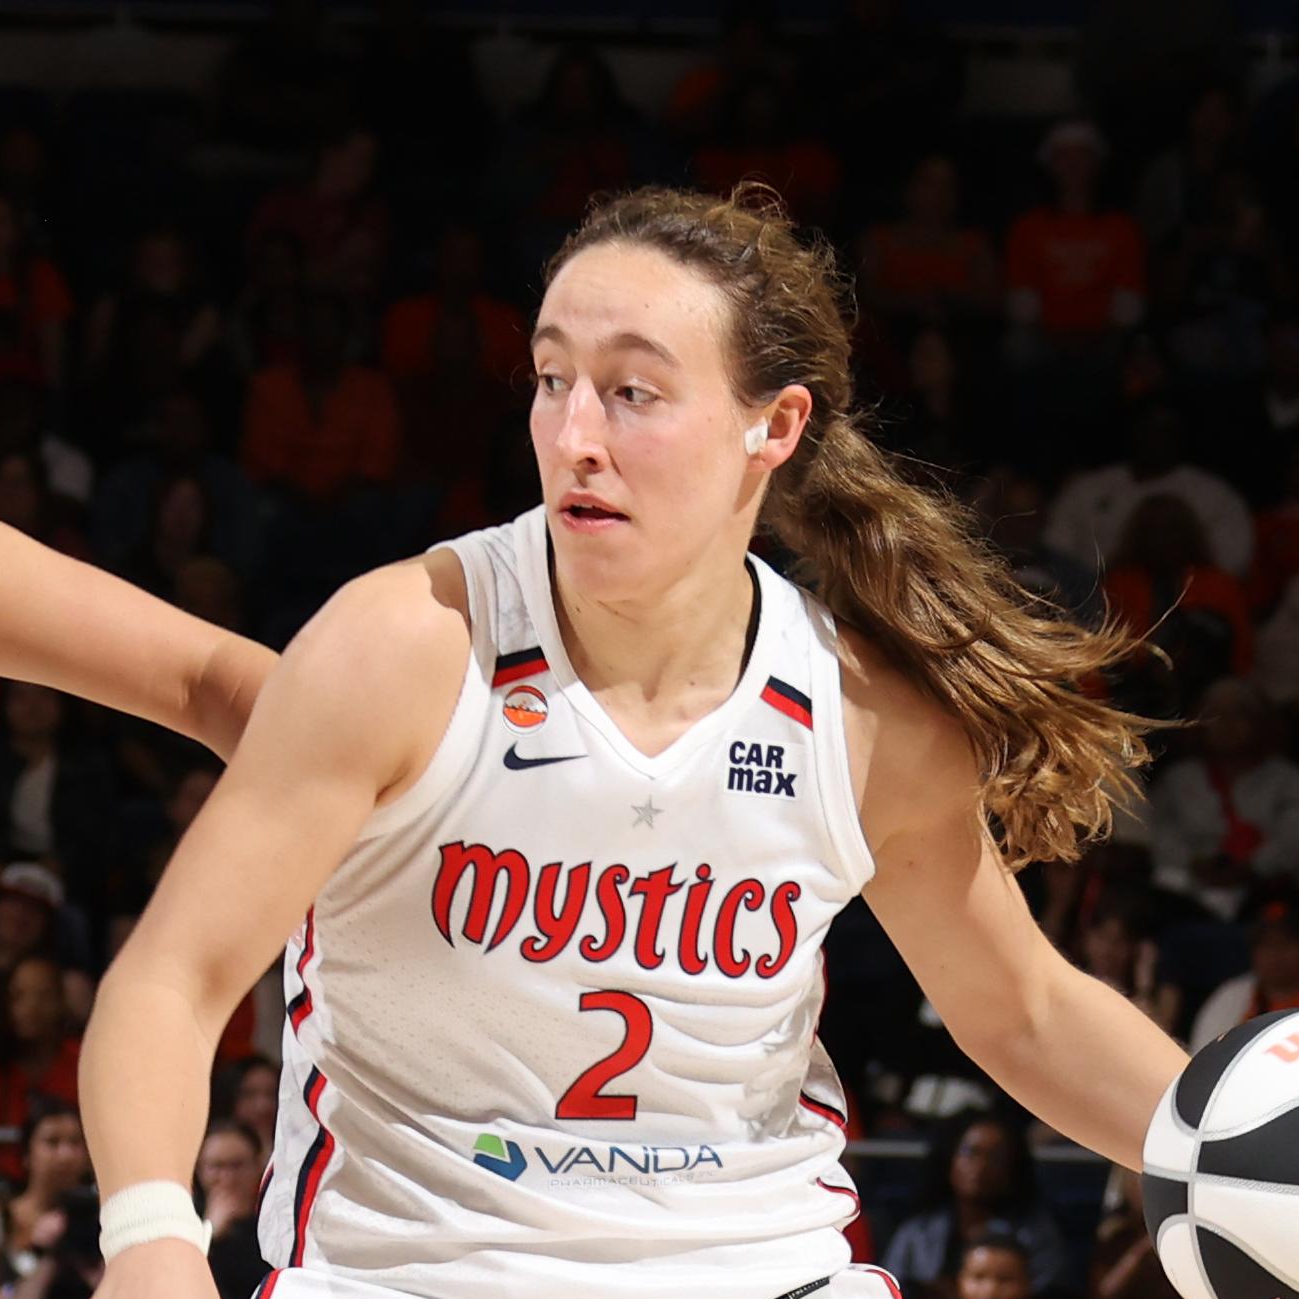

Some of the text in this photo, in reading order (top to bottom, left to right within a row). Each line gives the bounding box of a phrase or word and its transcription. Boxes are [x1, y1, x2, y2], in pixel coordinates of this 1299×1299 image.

[729, 740, 785, 769] CAR
[727, 767, 798, 798] max
[554, 988, 653, 1121] 2
[534, 1144, 724, 1174] VANDA
